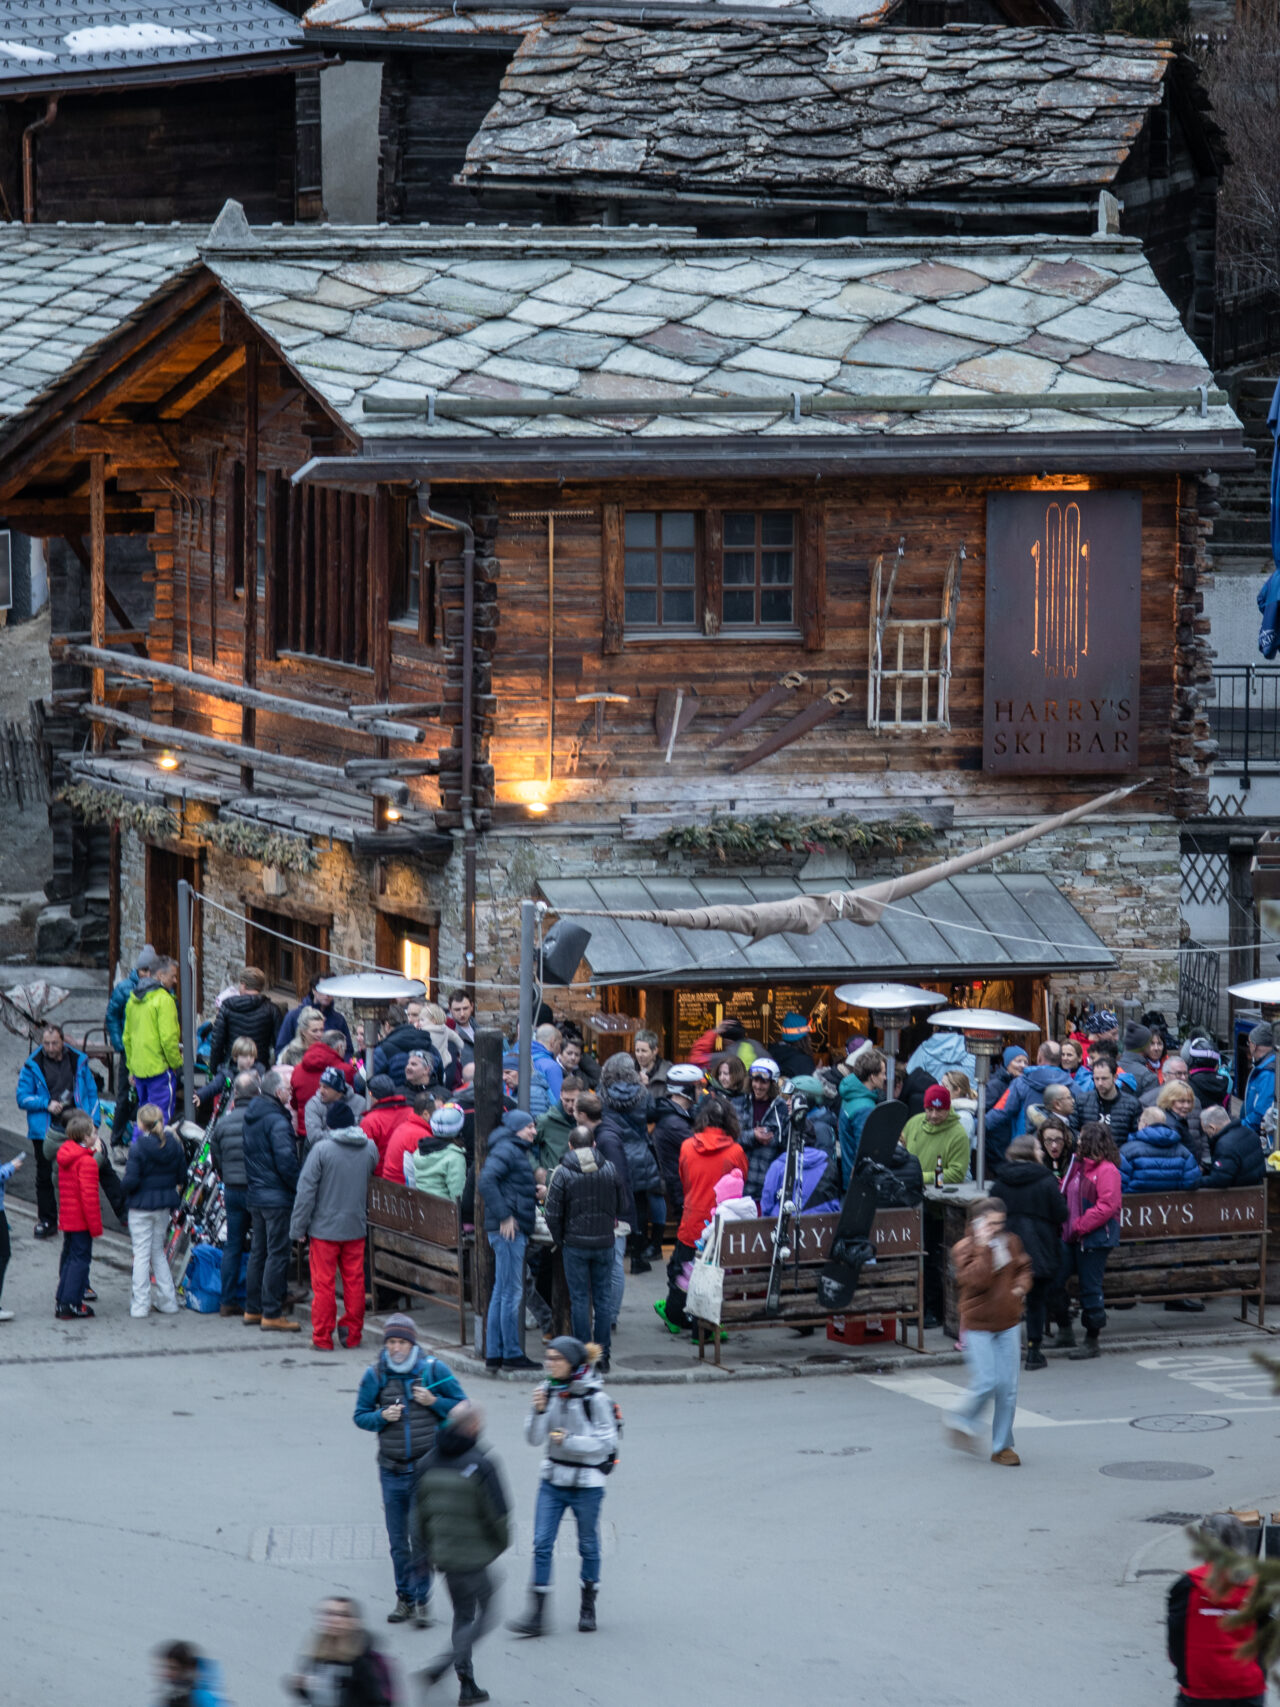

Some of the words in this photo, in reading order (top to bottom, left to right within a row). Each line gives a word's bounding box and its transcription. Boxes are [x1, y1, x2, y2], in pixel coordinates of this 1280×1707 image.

[994, 699, 1131, 722] HARRY'S
[994, 731, 1046, 755] SKI
[1066, 731, 1129, 753] BAR
[1120, 1203, 1194, 1227] RRY'S
[1220, 1206, 1255, 1222] BAR
[729, 1227, 833, 1255] HARY'
[876, 1227, 911, 1244] BAR
